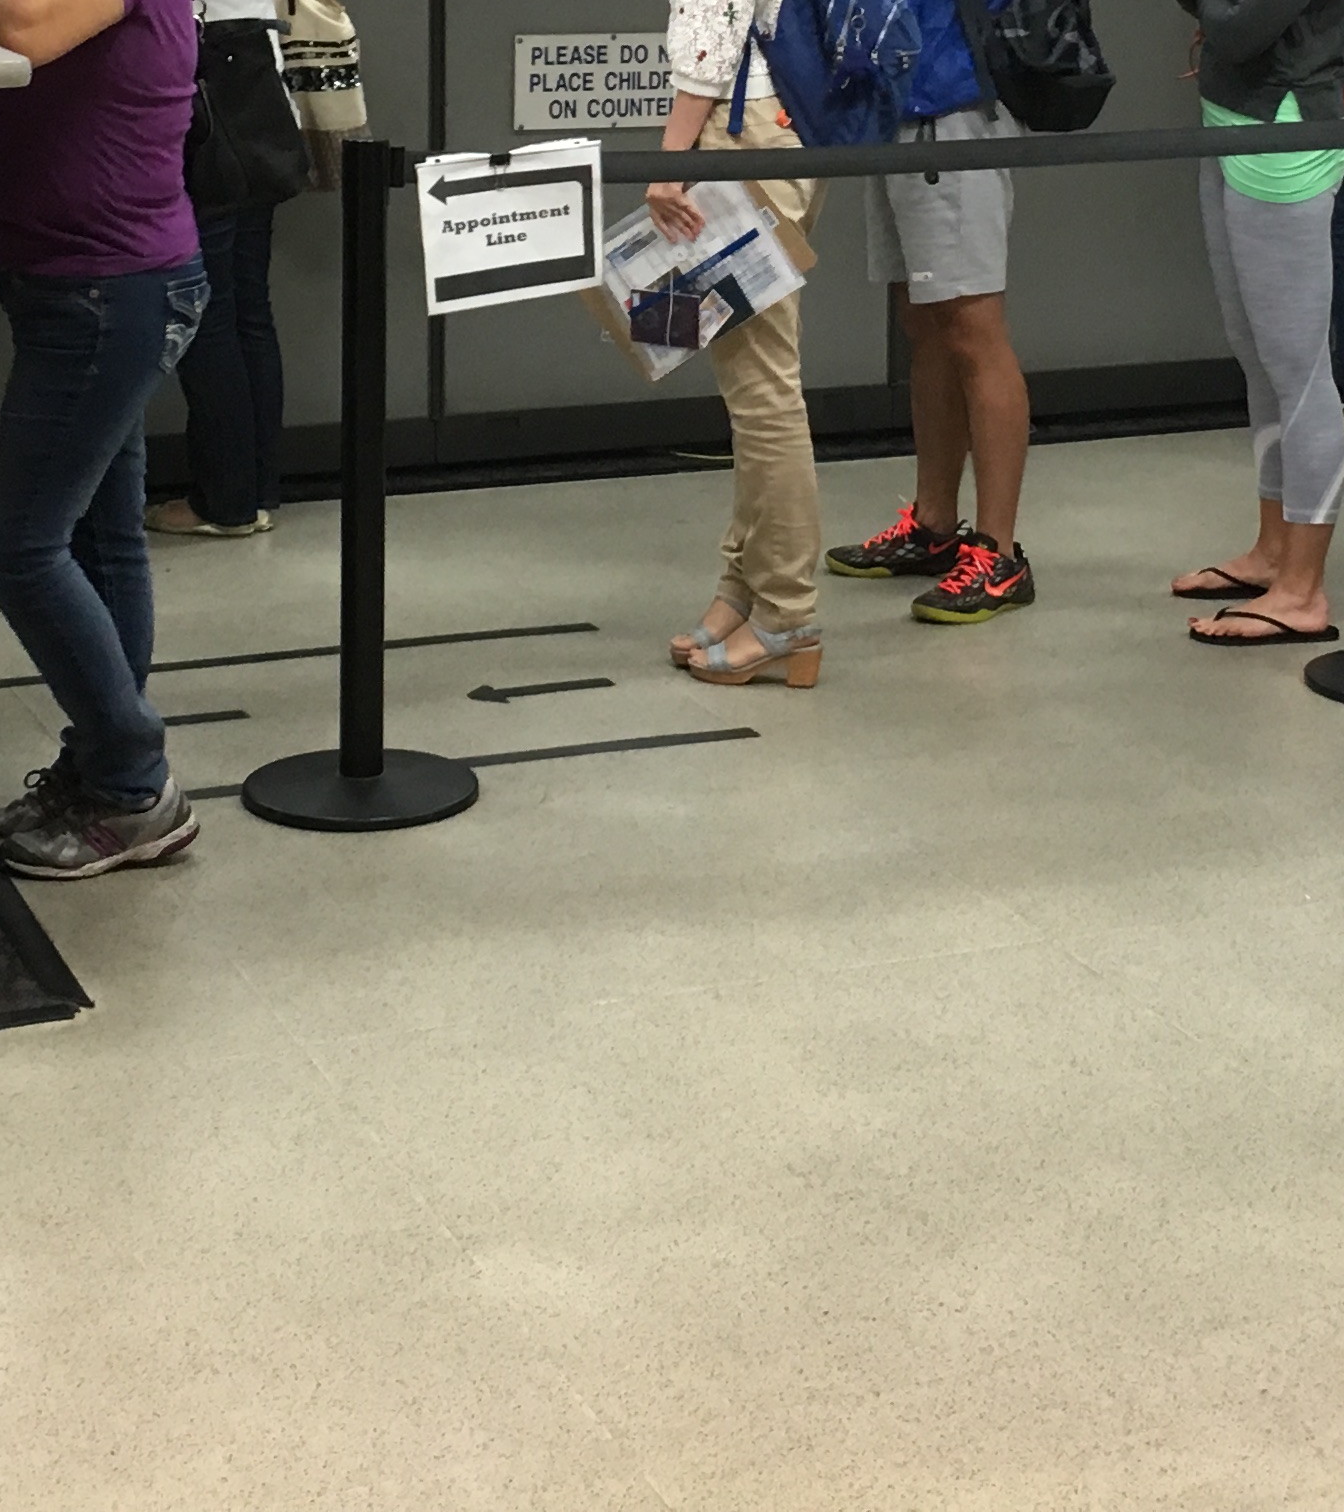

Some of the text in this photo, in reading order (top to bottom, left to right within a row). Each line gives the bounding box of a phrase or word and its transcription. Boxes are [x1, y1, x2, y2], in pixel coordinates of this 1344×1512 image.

[531, 44, 609, 65] PLEASE
[619, 44, 648, 64] DO
[529, 70, 671, 93] PLACE CHILDR
[548, 99, 577, 119] ON
[441, 204, 571, 235] Appointment
[486, 231, 528, 248] Line
